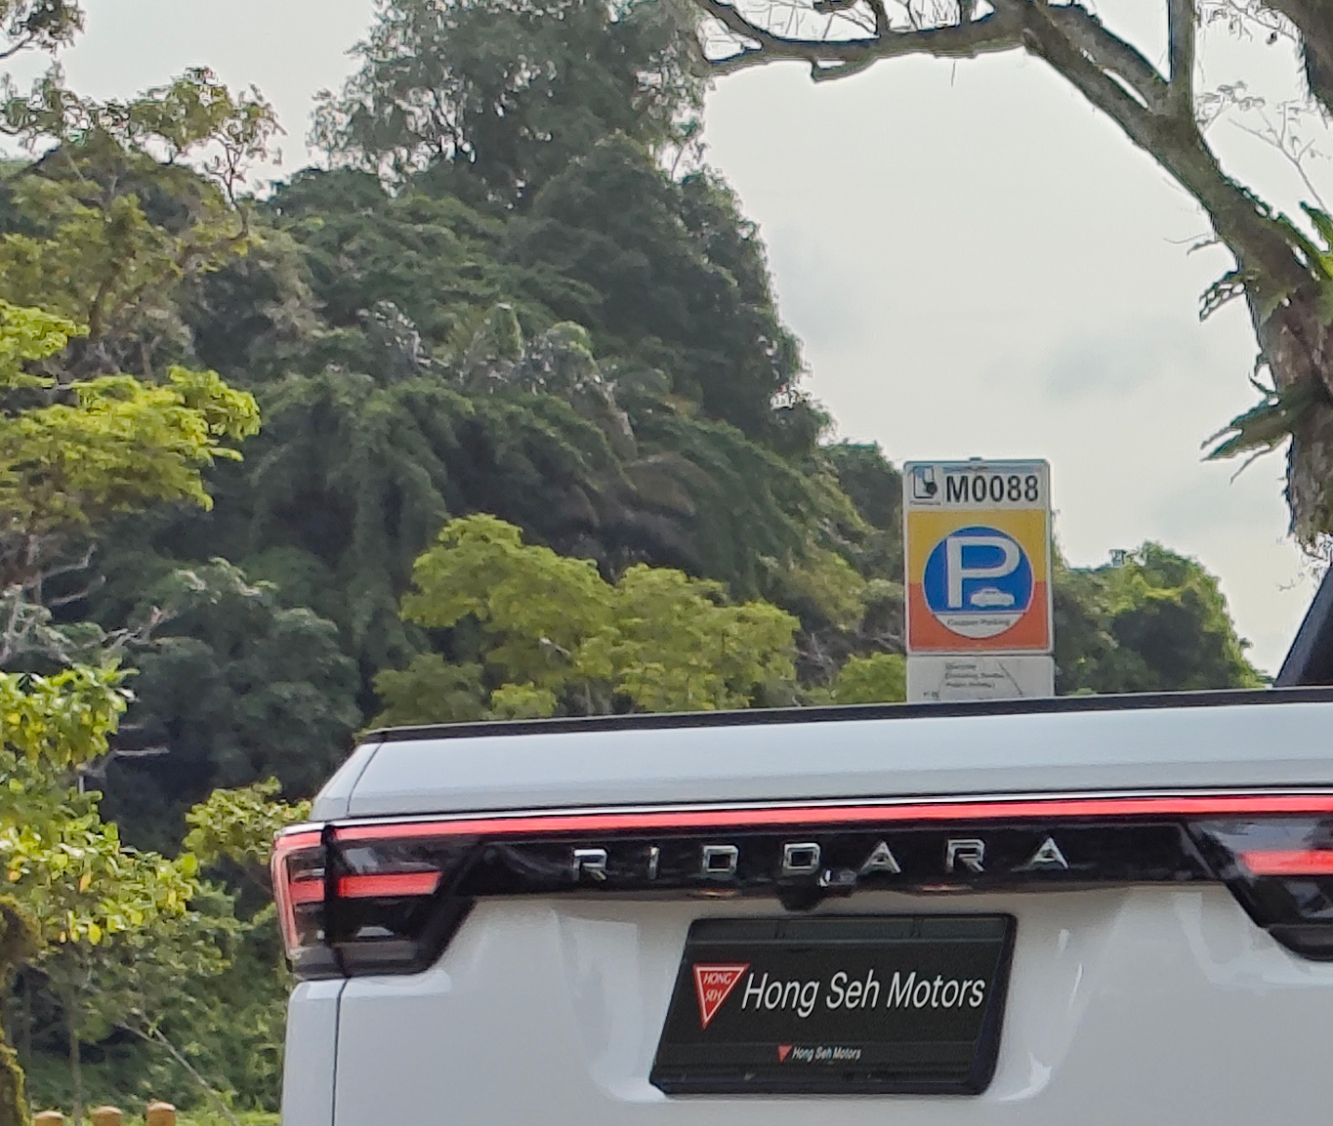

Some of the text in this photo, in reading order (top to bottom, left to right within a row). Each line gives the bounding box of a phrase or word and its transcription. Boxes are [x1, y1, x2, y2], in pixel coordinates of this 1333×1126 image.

[946, 475, 1039, 502] M0088
[946, 536, 1020, 608] P
[572, 835, 1069, 882] RIDDARA
[703, 972, 733, 985] HONG
[705, 989, 724, 1001] SEH
[741, 968, 986, 1018] Hong Seh Motors
[792, 1045, 862, 1063] Hong Seh Motors
